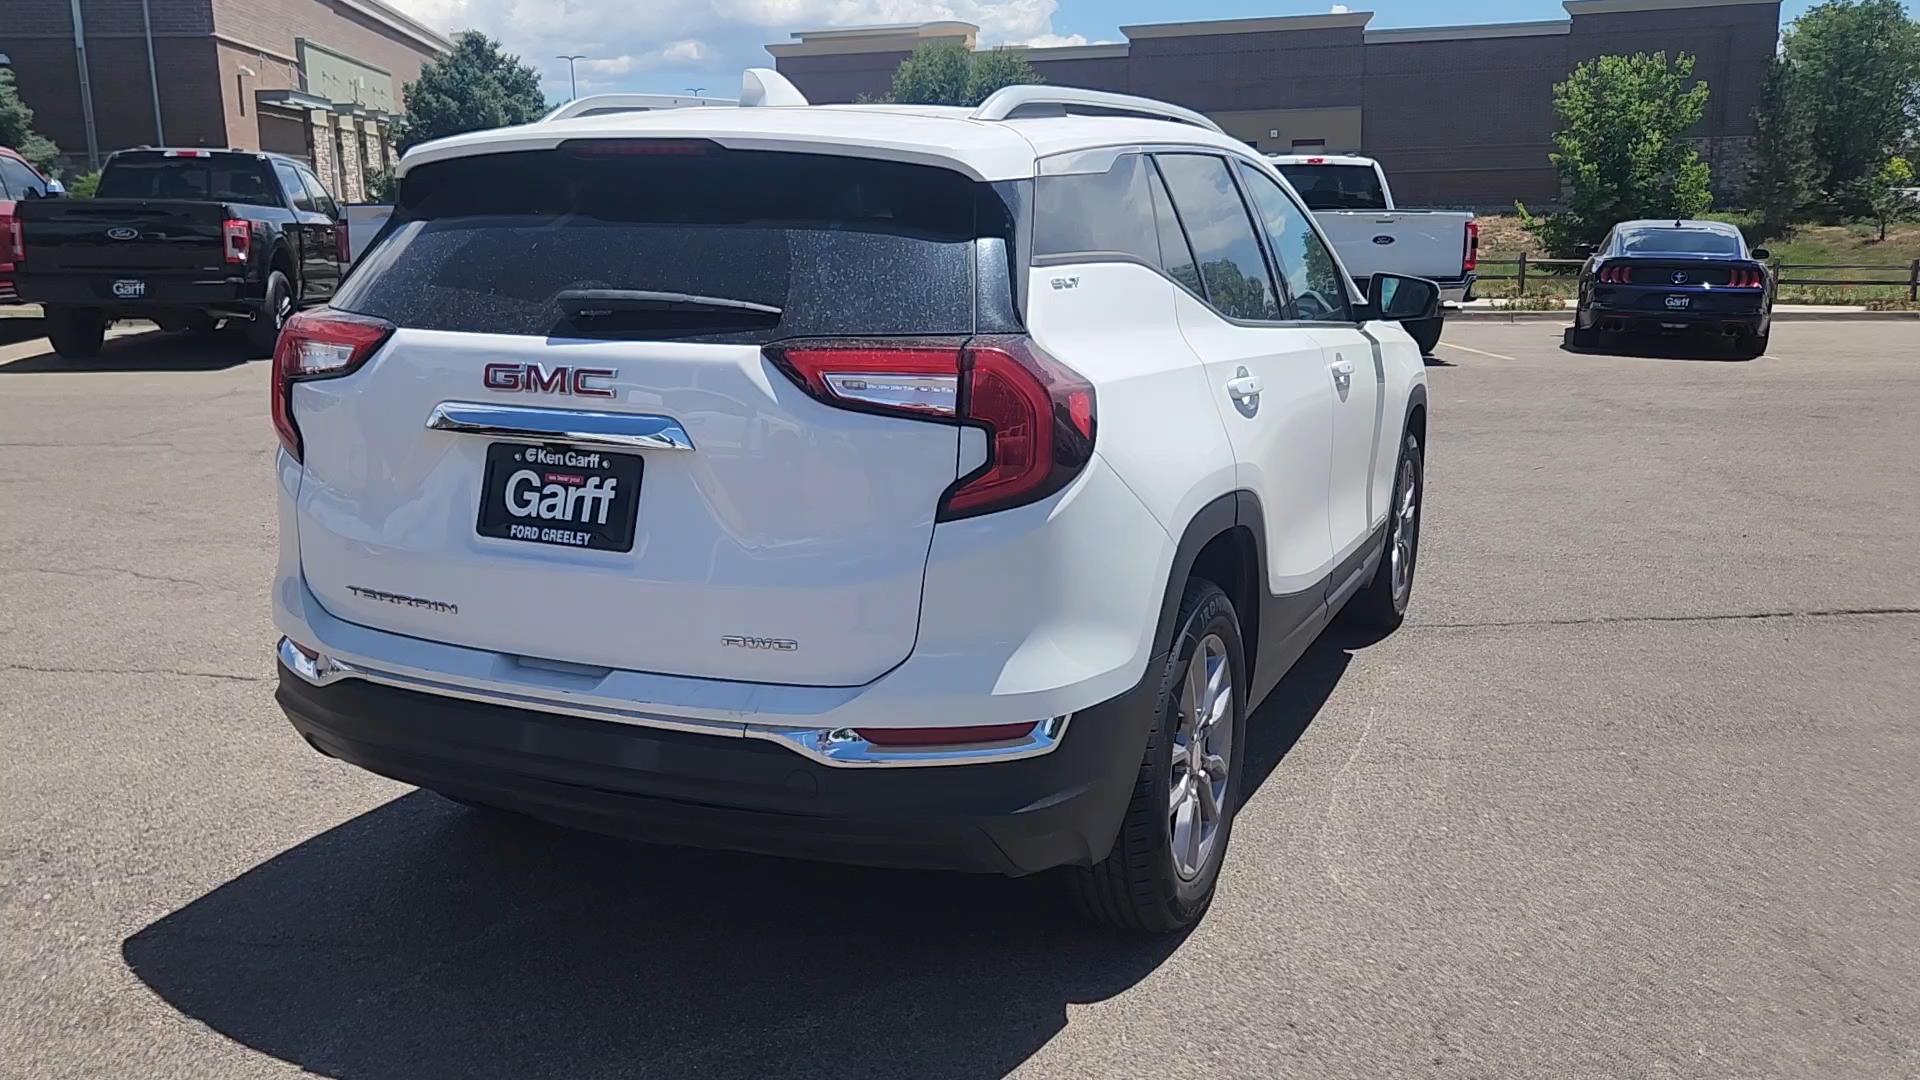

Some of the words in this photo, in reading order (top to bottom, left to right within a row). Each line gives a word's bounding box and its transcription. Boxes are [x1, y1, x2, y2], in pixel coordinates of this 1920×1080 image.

[112, 282, 146, 295] Garff
[1665, 297, 1690, 306] Garff
[483, 361, 618, 398] GMC
[537, 448, 563, 466] Ken
[565, 451, 600, 469] Garff
[505, 469, 617, 525] Garff
[510, 524, 539, 540] FORD
[541, 528, 591, 545] GREELEY
[346, 585, 459, 615] TERRAIN
[721, 634, 798, 652] AWD
